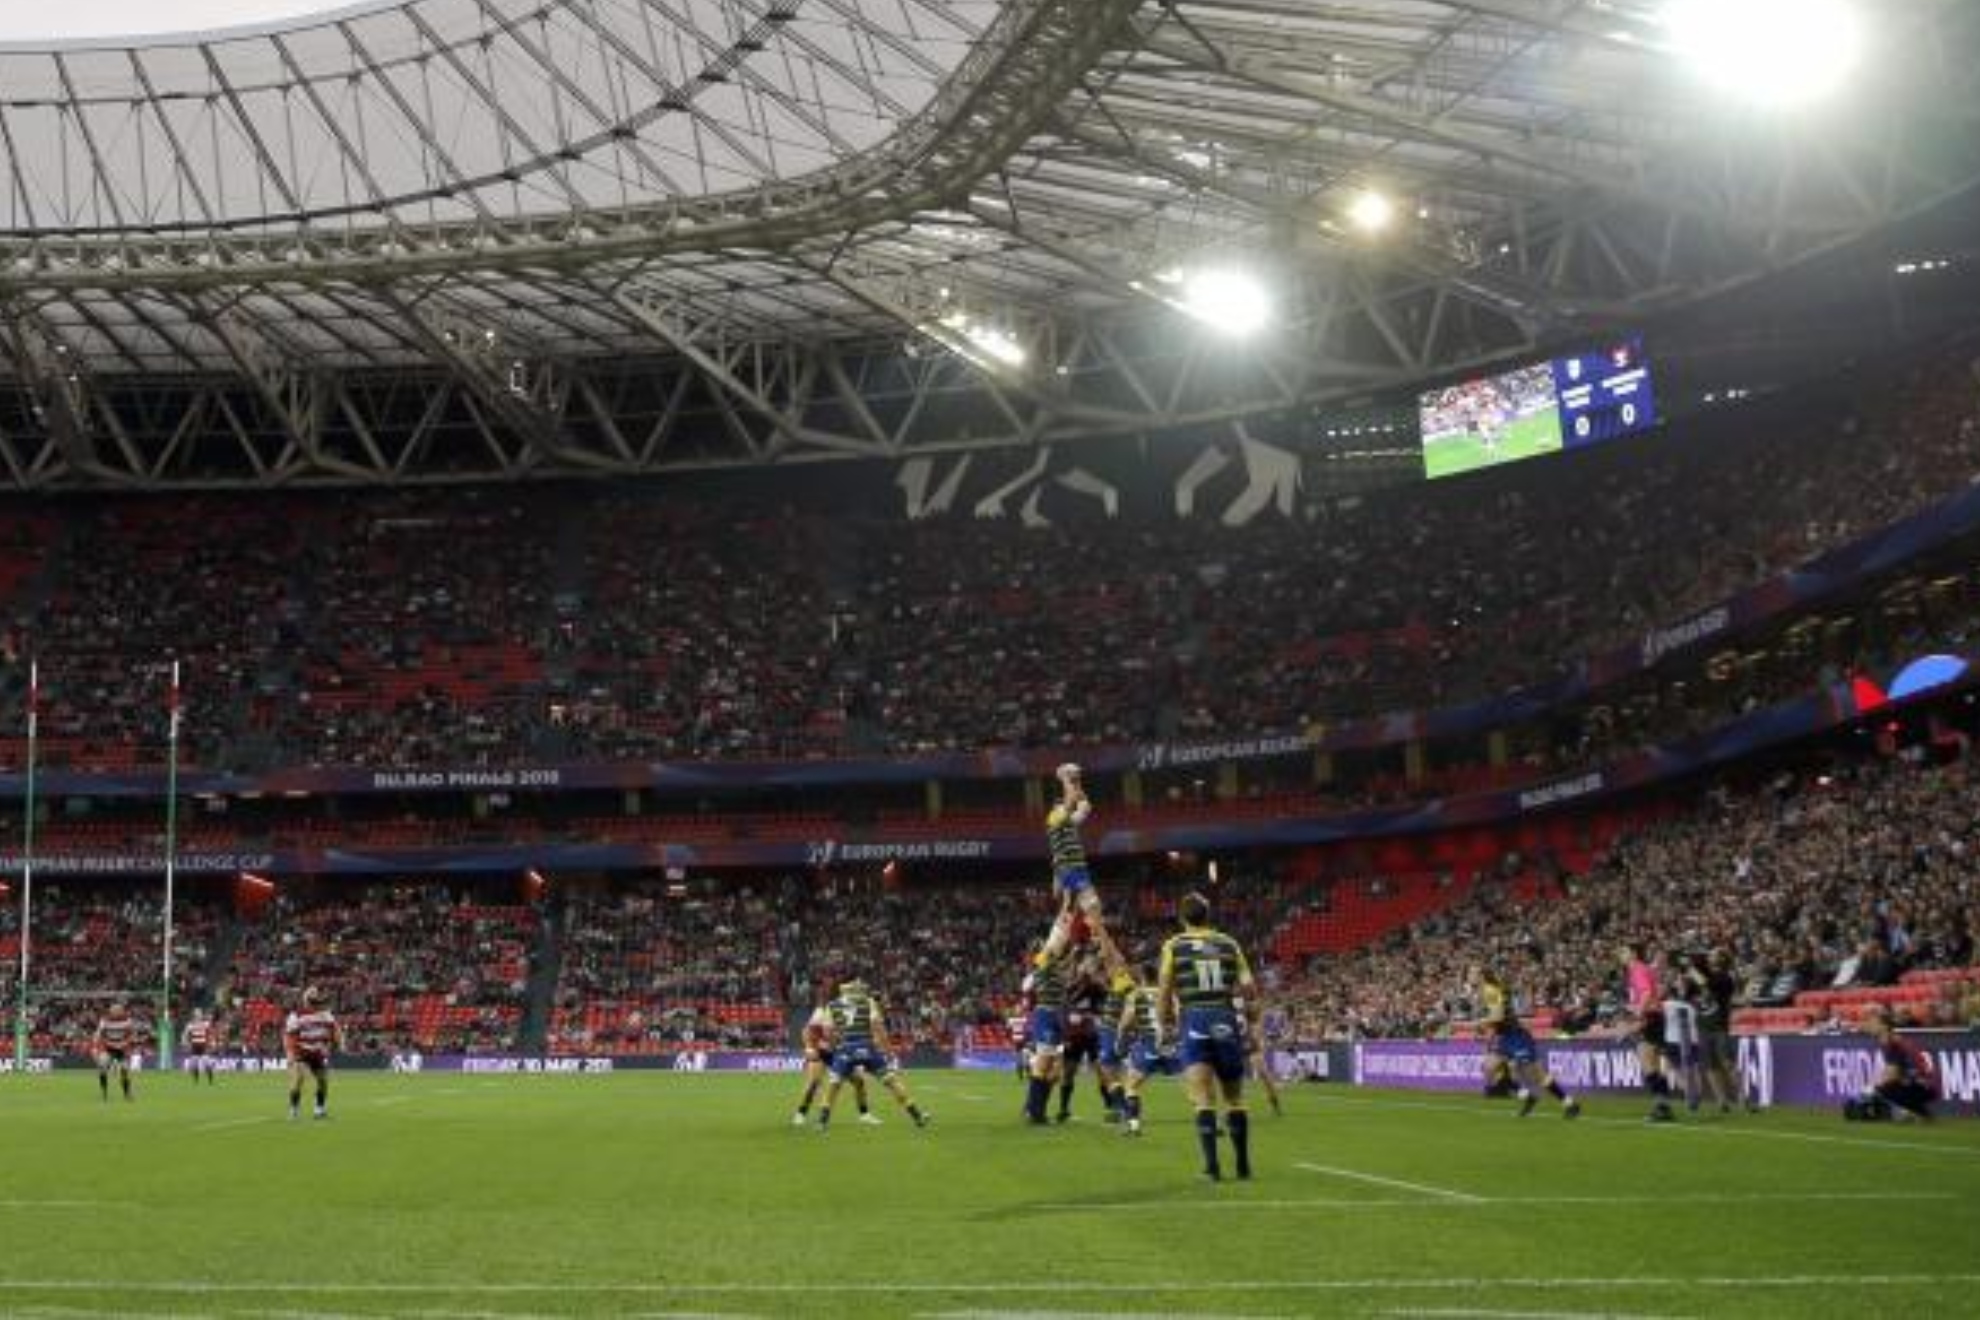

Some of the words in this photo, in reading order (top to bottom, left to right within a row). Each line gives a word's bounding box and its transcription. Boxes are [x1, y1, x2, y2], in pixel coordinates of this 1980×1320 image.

[373, 772, 444, 788] BILBAO
[448, 771, 514, 786] FINALS
[842, 843, 930, 860] EUROPEAN
[934, 841, 992, 857] RUGBY
[239, 854, 273, 869] CUP
[1195, 960, 1223, 992] 11
[1823, 1048, 1885, 1097] FRIDA
[1937, 1050, 1980, 1101] MA
